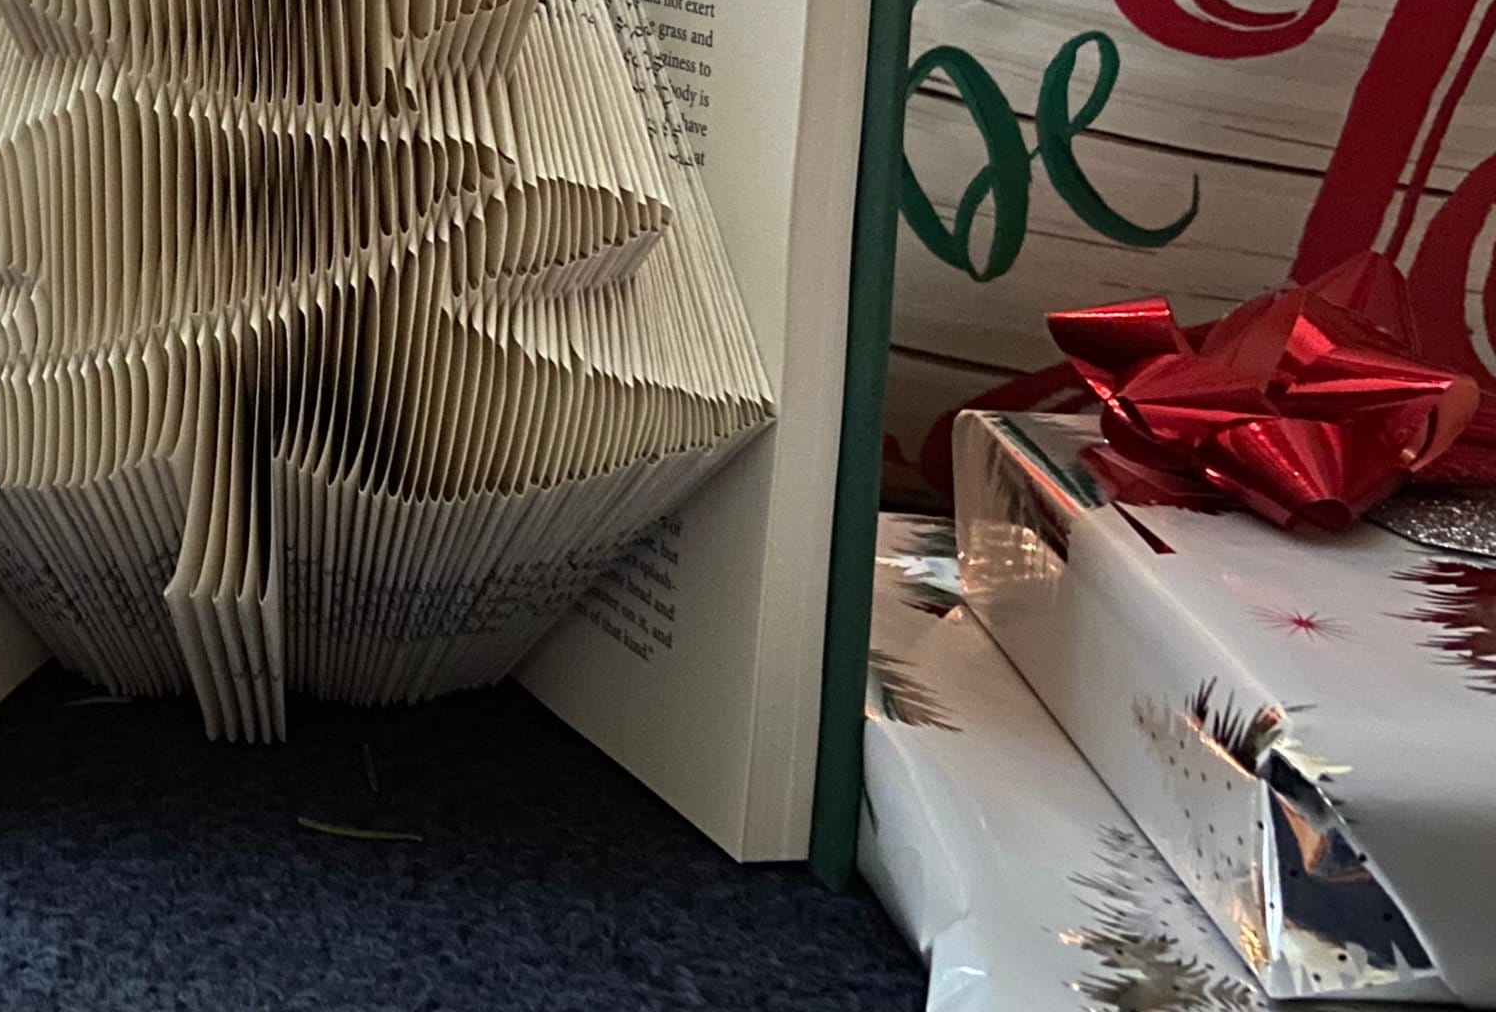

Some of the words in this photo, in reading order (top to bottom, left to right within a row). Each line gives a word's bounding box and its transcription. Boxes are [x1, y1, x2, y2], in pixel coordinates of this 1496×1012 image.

[658, 23, 687, 42] grass
[690, 29, 713, 48] and
[698, 61, 711, 78] to
[699, 89, 710, 107] is
